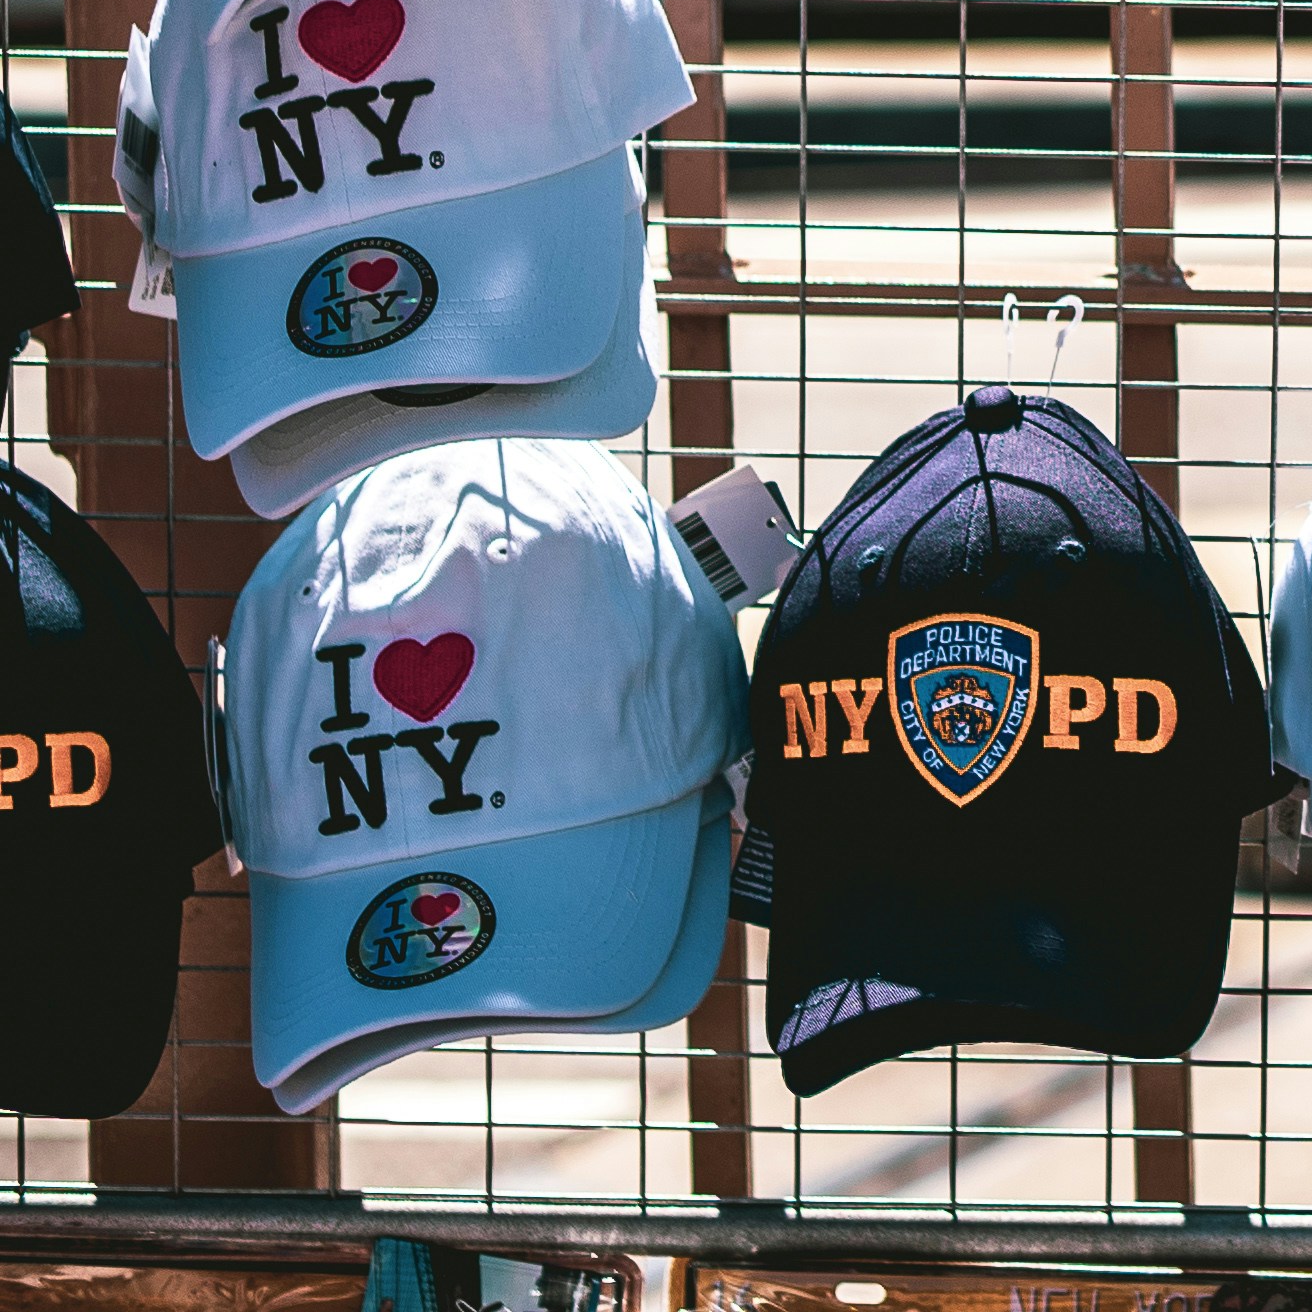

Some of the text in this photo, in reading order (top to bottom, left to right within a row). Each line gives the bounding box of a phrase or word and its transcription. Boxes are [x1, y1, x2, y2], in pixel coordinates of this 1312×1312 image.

[249, 6, 299, 100] I
[321, 266, 346, 303] I
[900, 644, 1028, 679] DEPARTMENT
[926, 624, 1003, 648] POLICE
[315, 643, 370, 733] I
[779, 675, 1178, 759] NY PD
[900, 700, 944, 771] CITY OF
[971, 687, 1031, 780] NEW YORK
[383, 898, 408, 934] I
